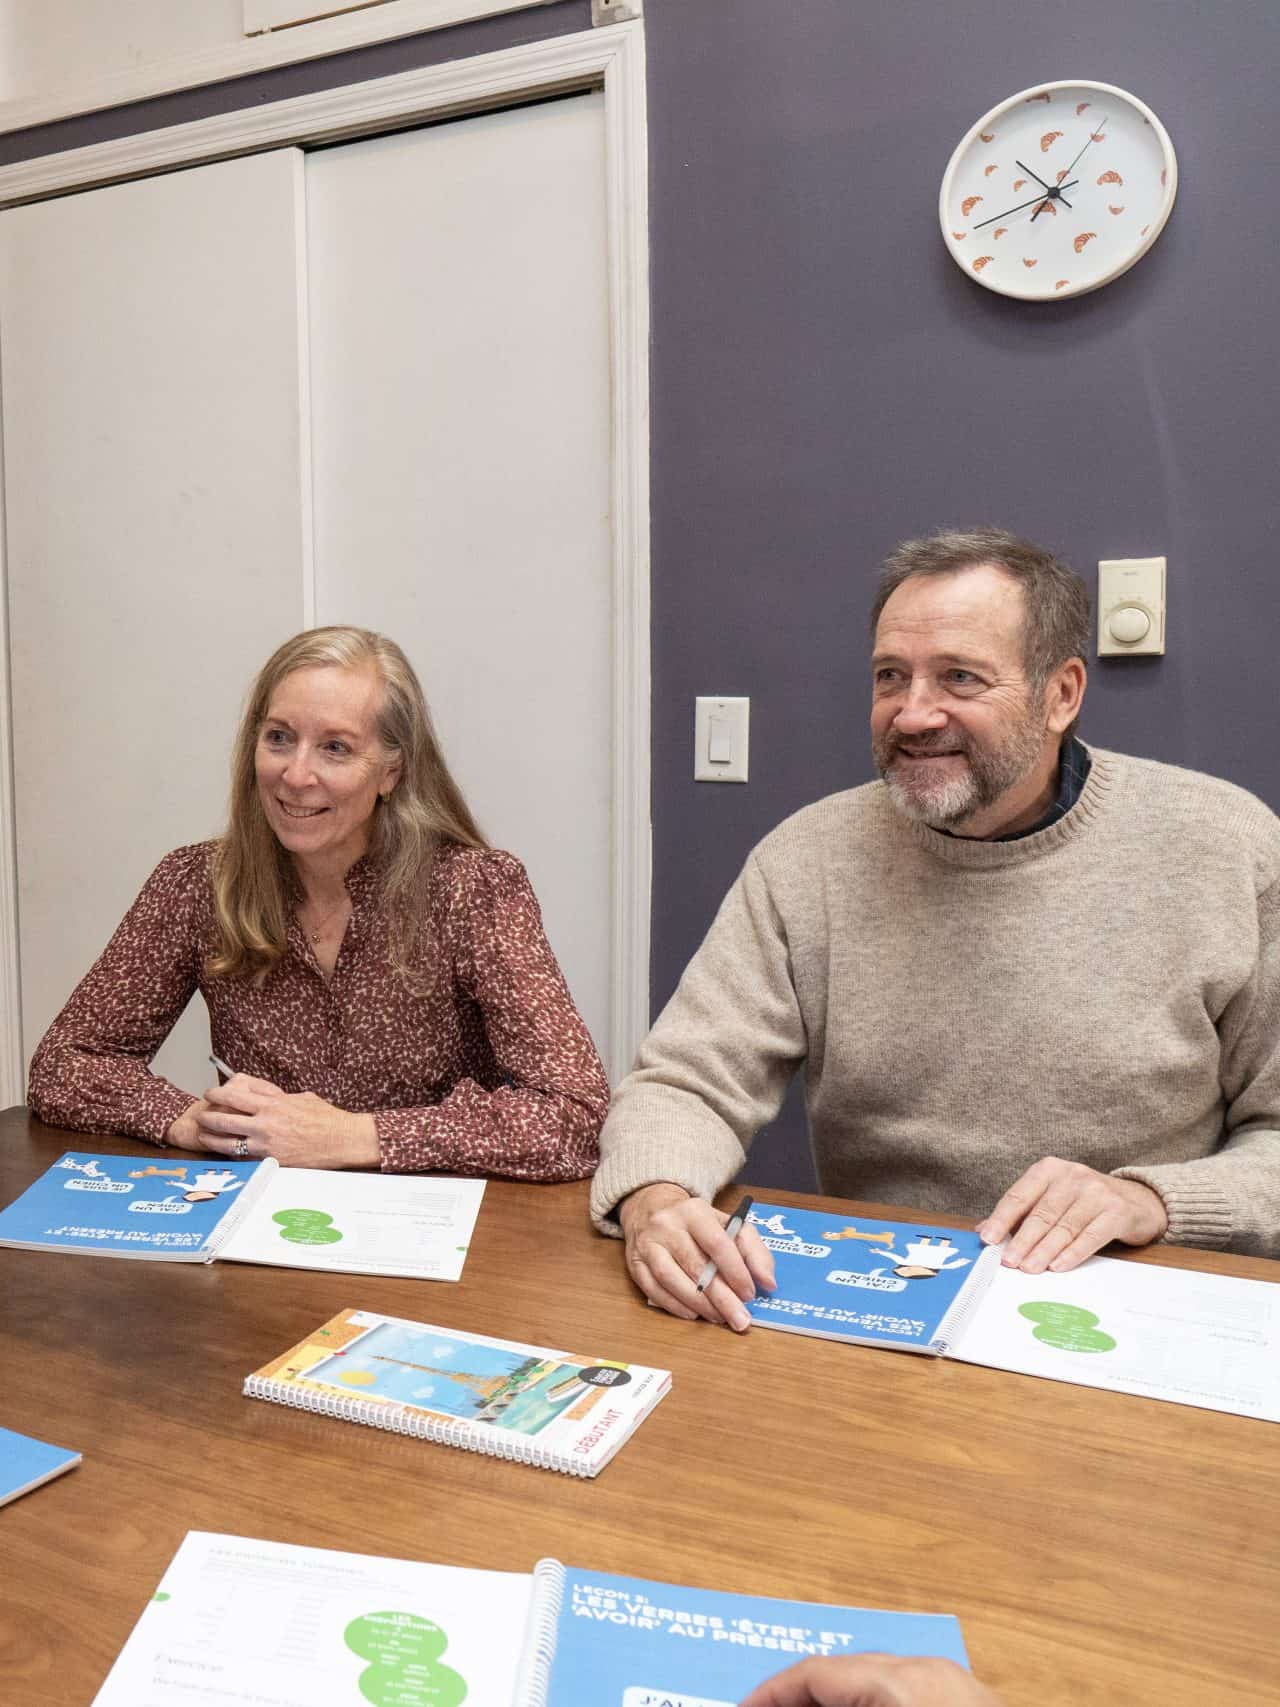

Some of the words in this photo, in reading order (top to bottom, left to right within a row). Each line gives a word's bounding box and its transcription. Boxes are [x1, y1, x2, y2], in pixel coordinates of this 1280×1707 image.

[834, 1276, 857, 1284] UN
[850, 1274, 897, 1285] CHIEN
[830, 1308, 857, 1317] AU
[572, 1592, 617, 1611] LES
[624, 1601, 724, 1629] VERBES
[820, 1630, 855, 1647] ET
[668, 1622, 705, 1638] AU
